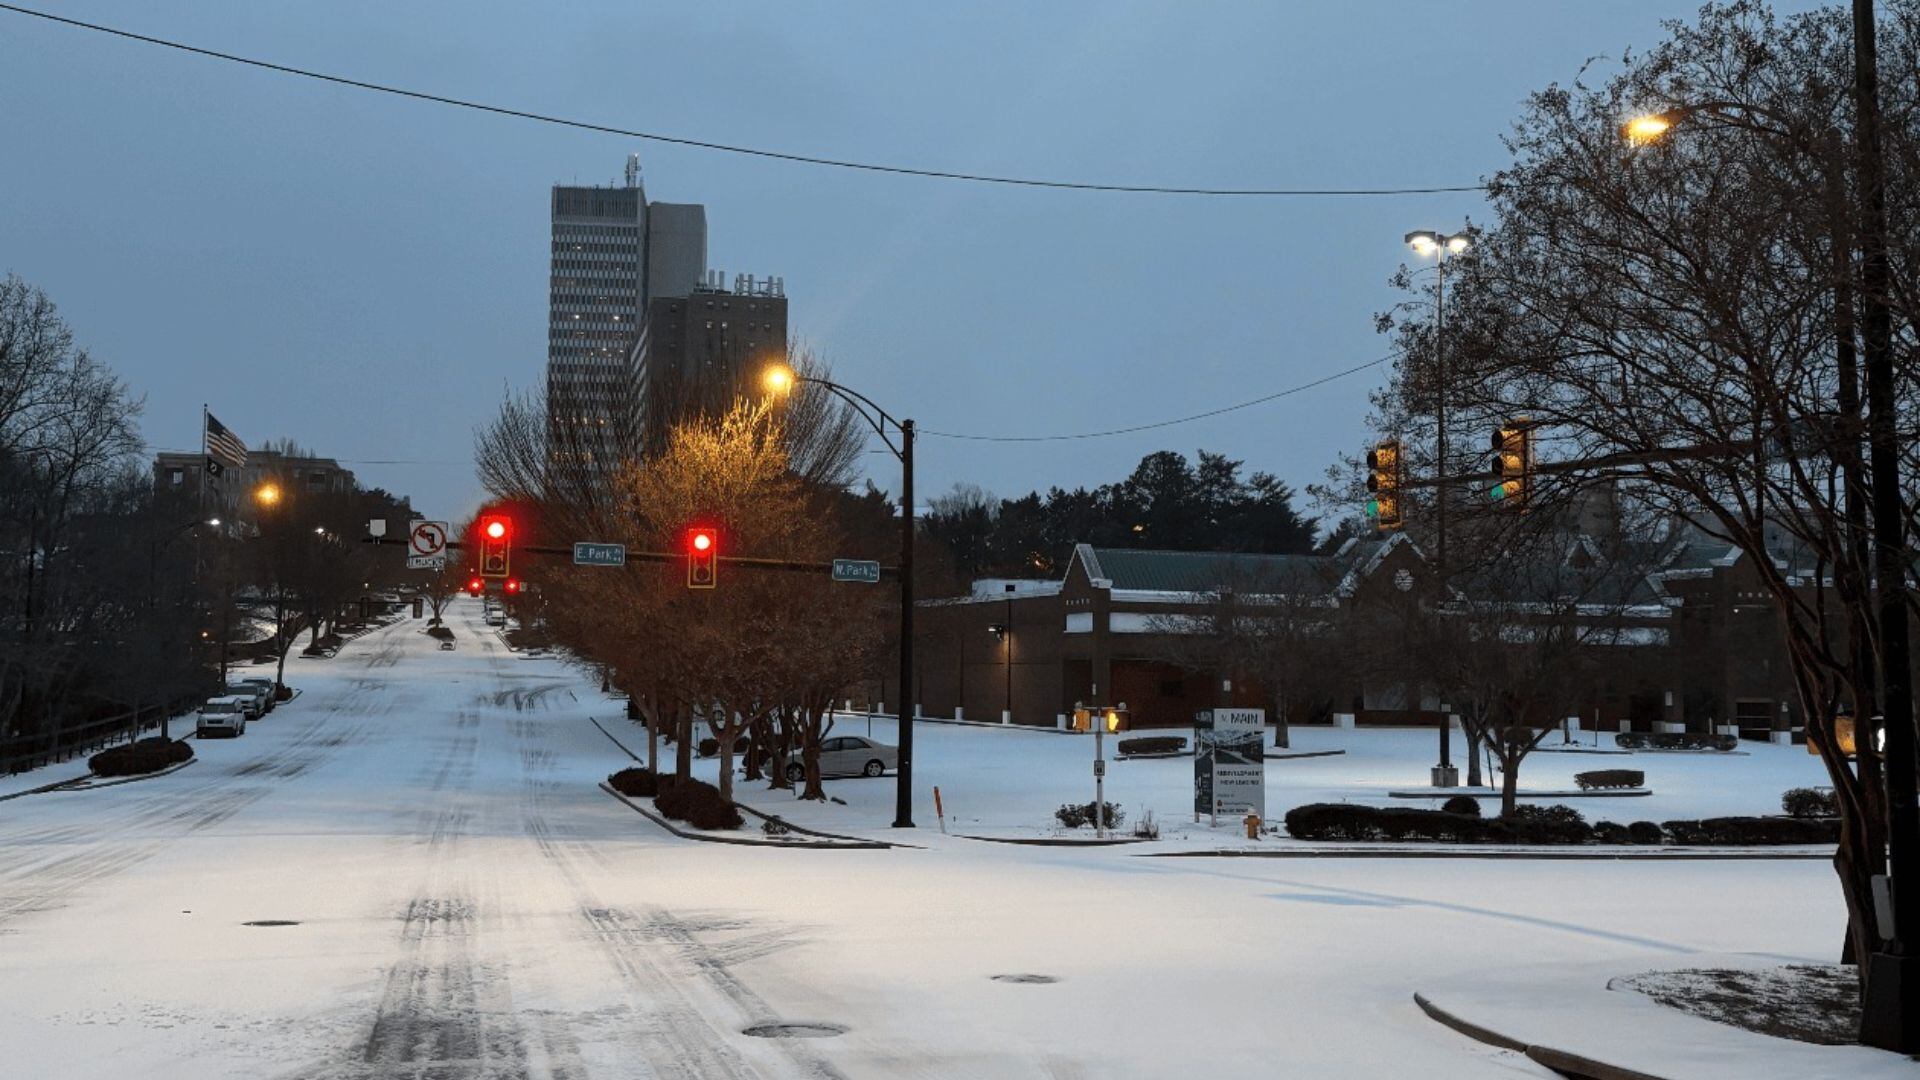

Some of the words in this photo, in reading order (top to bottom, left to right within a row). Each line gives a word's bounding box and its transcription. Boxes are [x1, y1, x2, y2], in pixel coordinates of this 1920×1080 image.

[577, 548, 586, 559] E.
[589, 548, 612, 560] Park
[410, 558, 444, 568] TRUCKS
[847, 564, 868, 577] Park
[1230, 712, 1258, 725] MAIN
